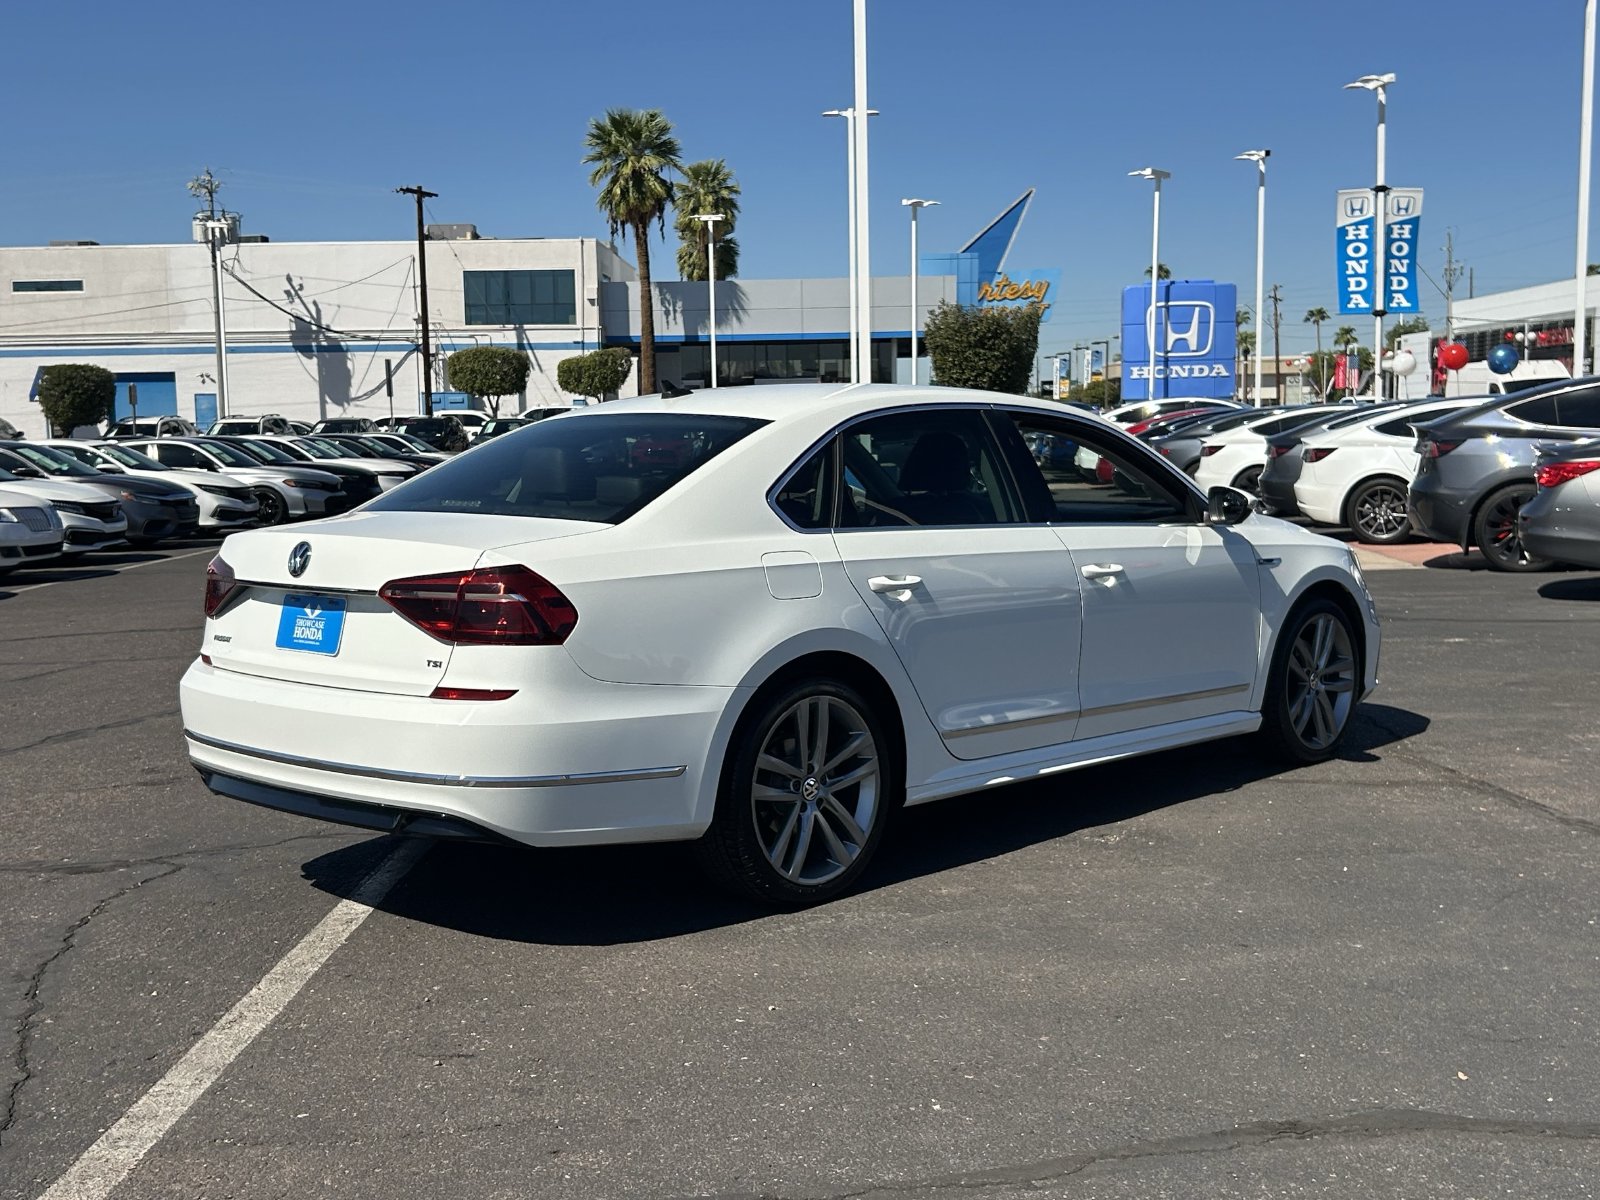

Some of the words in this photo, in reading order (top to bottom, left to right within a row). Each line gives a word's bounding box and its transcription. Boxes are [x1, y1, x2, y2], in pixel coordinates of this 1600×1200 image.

[1345, 224, 1370, 309] HONDA
[1389, 224, 1412, 308] HONDA
[1129, 363, 1230, 380] HONDA
[295, 618, 326, 630] SHOWCASE
[293, 626, 323, 641] HONDA
[426, 659, 443, 669] TSI
